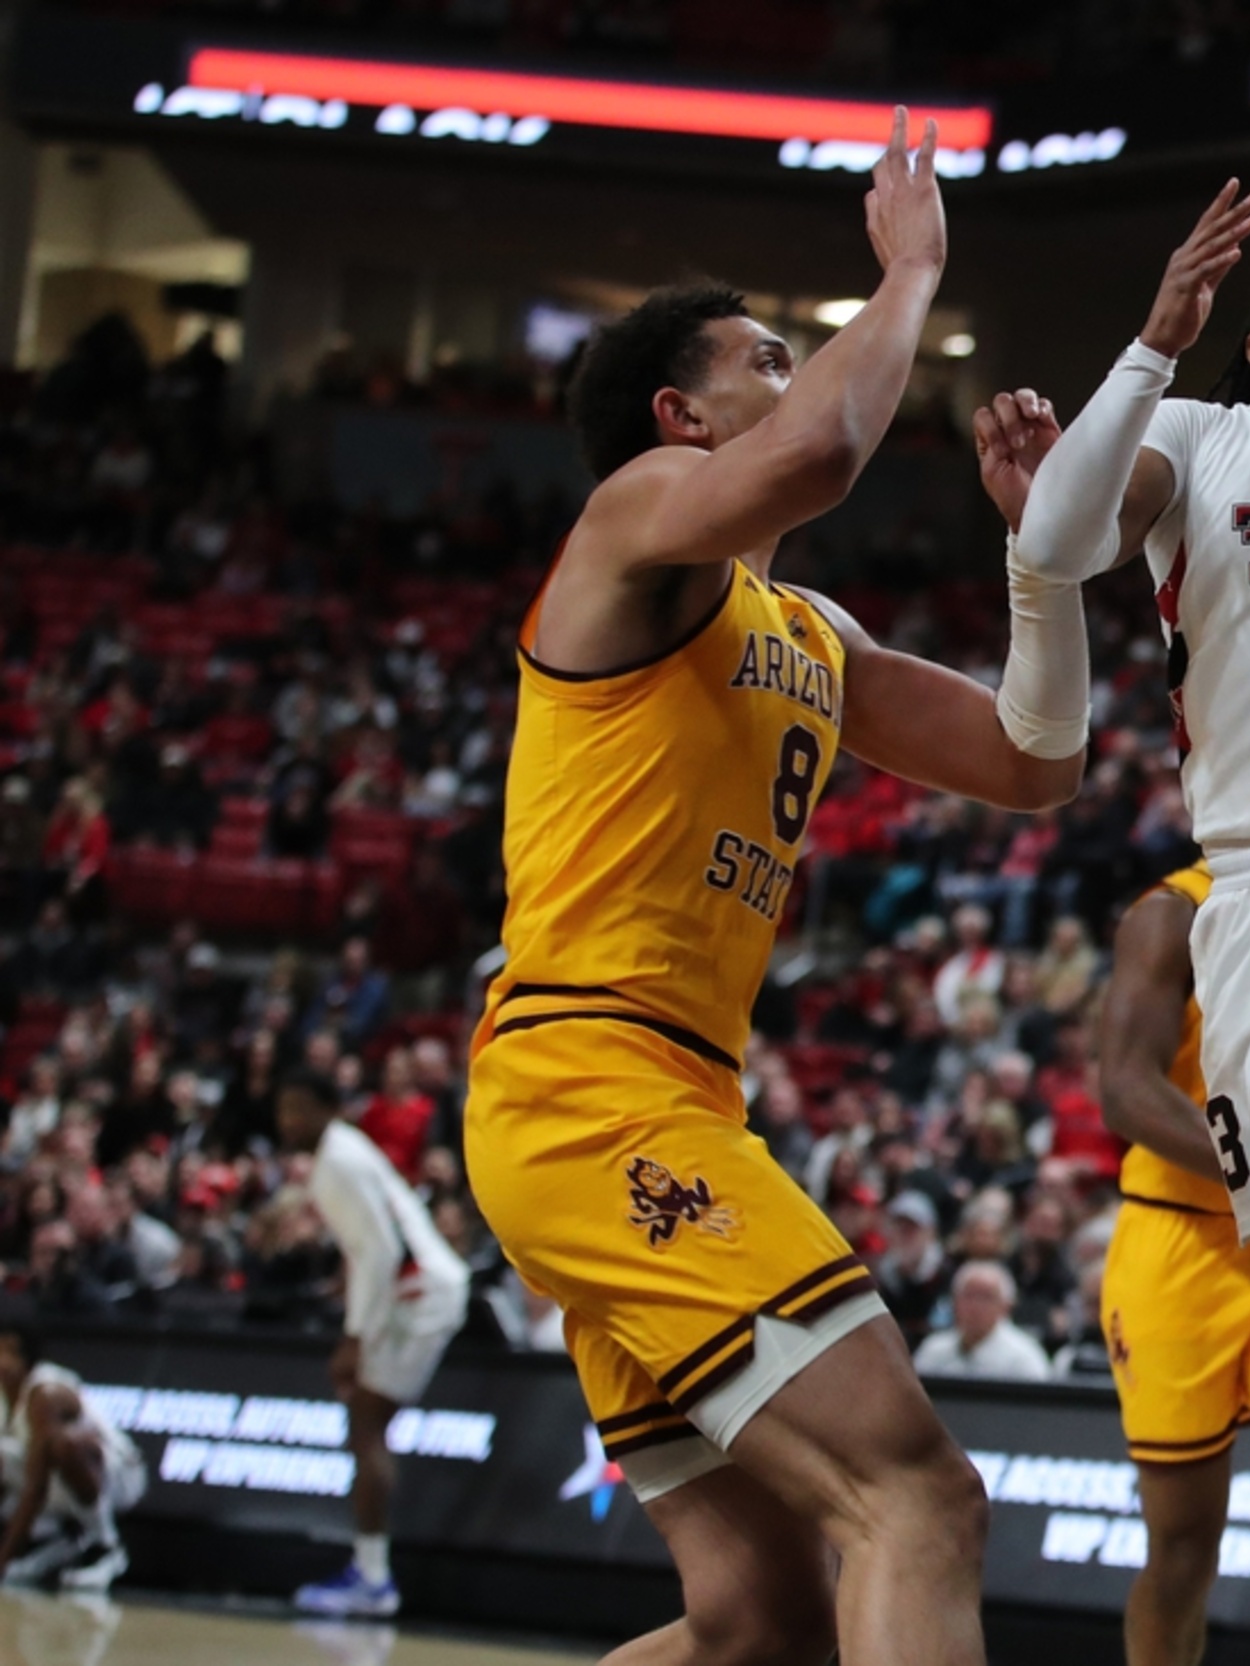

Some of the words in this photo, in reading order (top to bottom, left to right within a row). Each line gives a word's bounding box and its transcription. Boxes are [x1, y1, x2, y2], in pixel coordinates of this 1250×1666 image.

[729, 631, 843, 727] ARIZO
[773, 722, 821, 846] 8
[1206, 1094, 1250, 1193] 3
